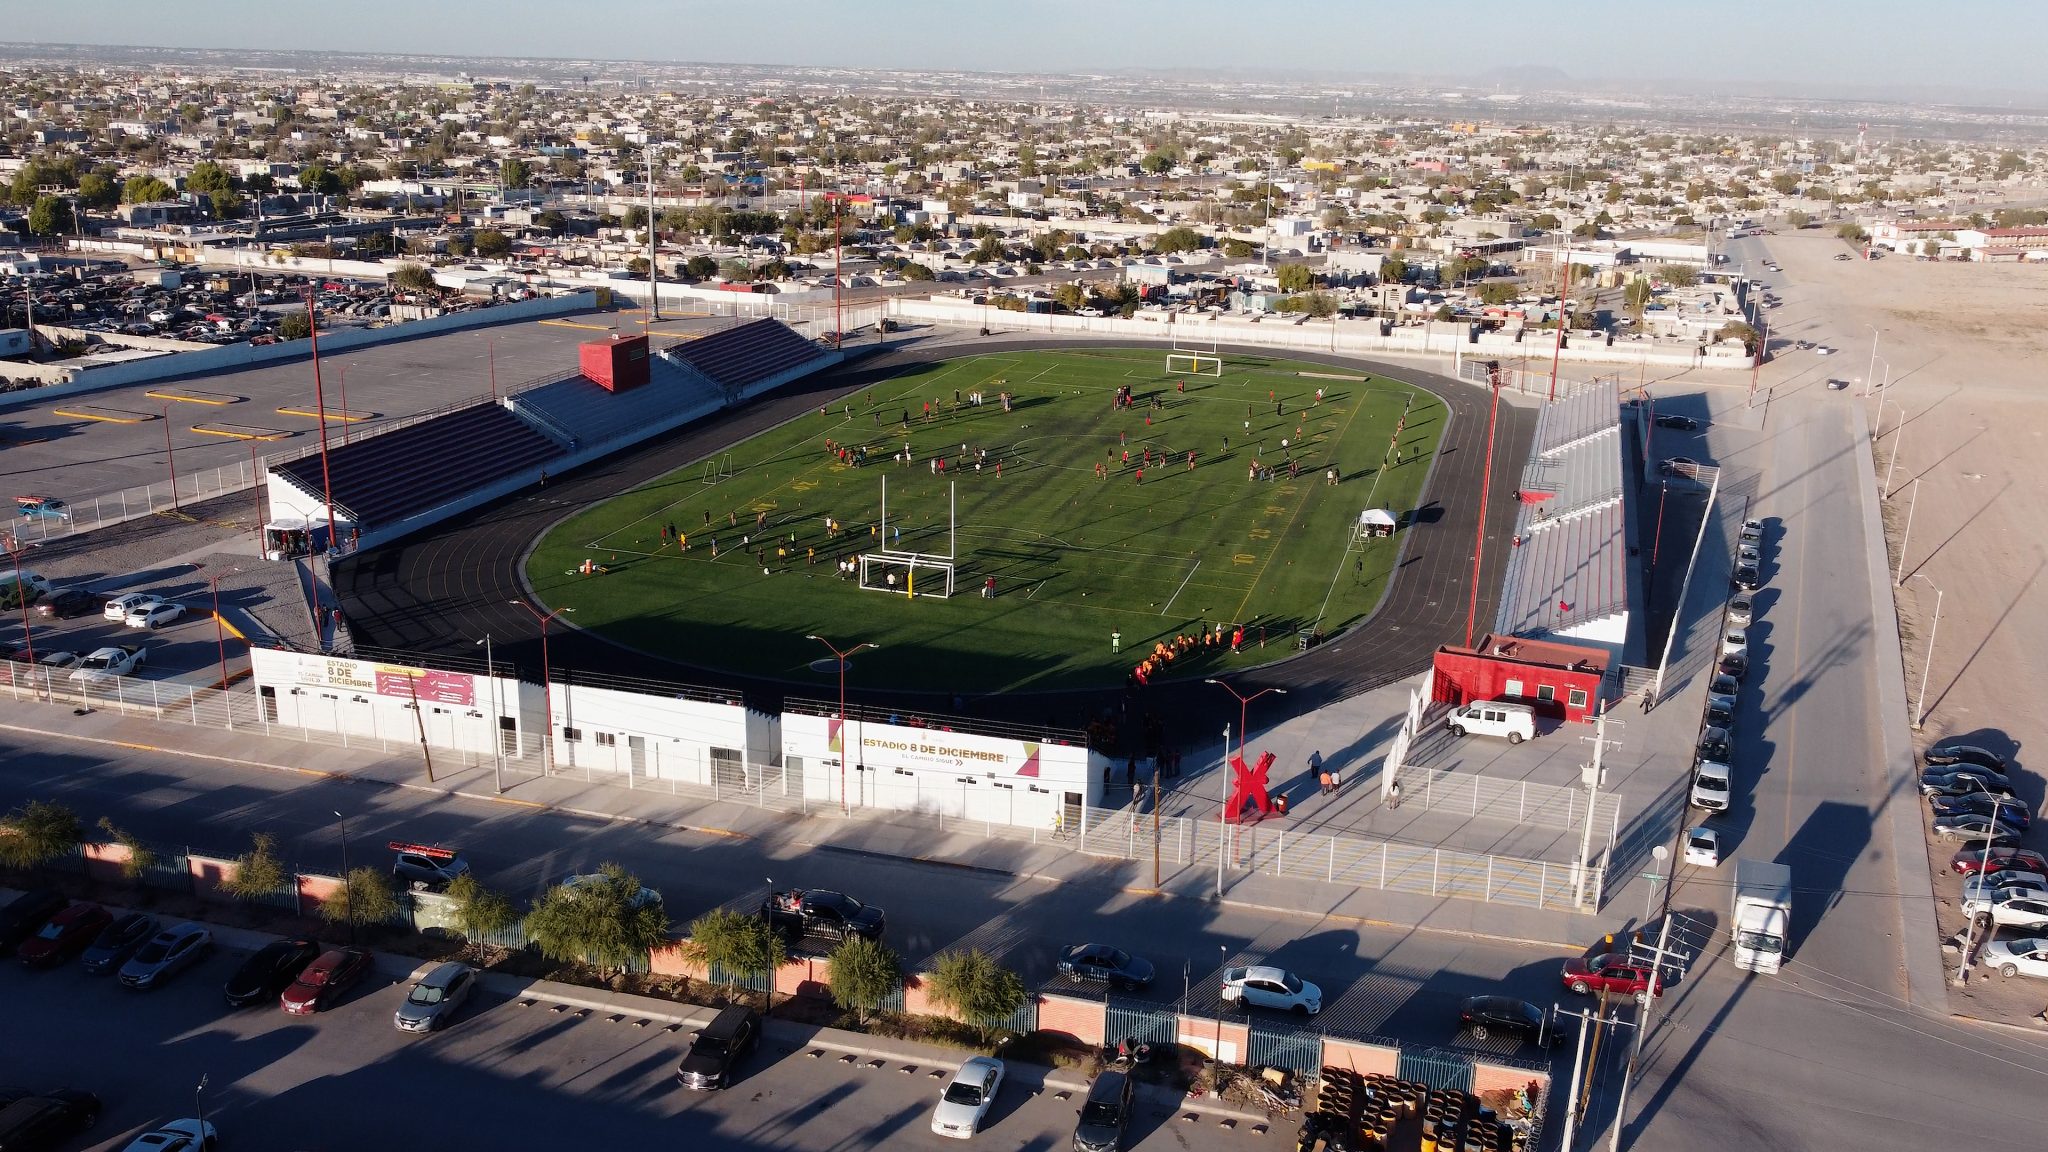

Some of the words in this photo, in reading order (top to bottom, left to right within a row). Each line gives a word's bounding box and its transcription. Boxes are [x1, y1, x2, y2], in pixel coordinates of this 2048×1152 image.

[327, 660, 358, 669] ESTADIO
[328, 667, 334, 675] 8
[337, 668, 352, 678] DE
[328, 676, 373, 688] DICIEMBRE
[863, 738, 908, 750] ESTADIO
[910, 743, 917, 752] 8
[920, 744, 936, 754] DE
[938, 746, 1005, 763] DICIEMBRE
[910, 754, 934, 762] CAMBIO
